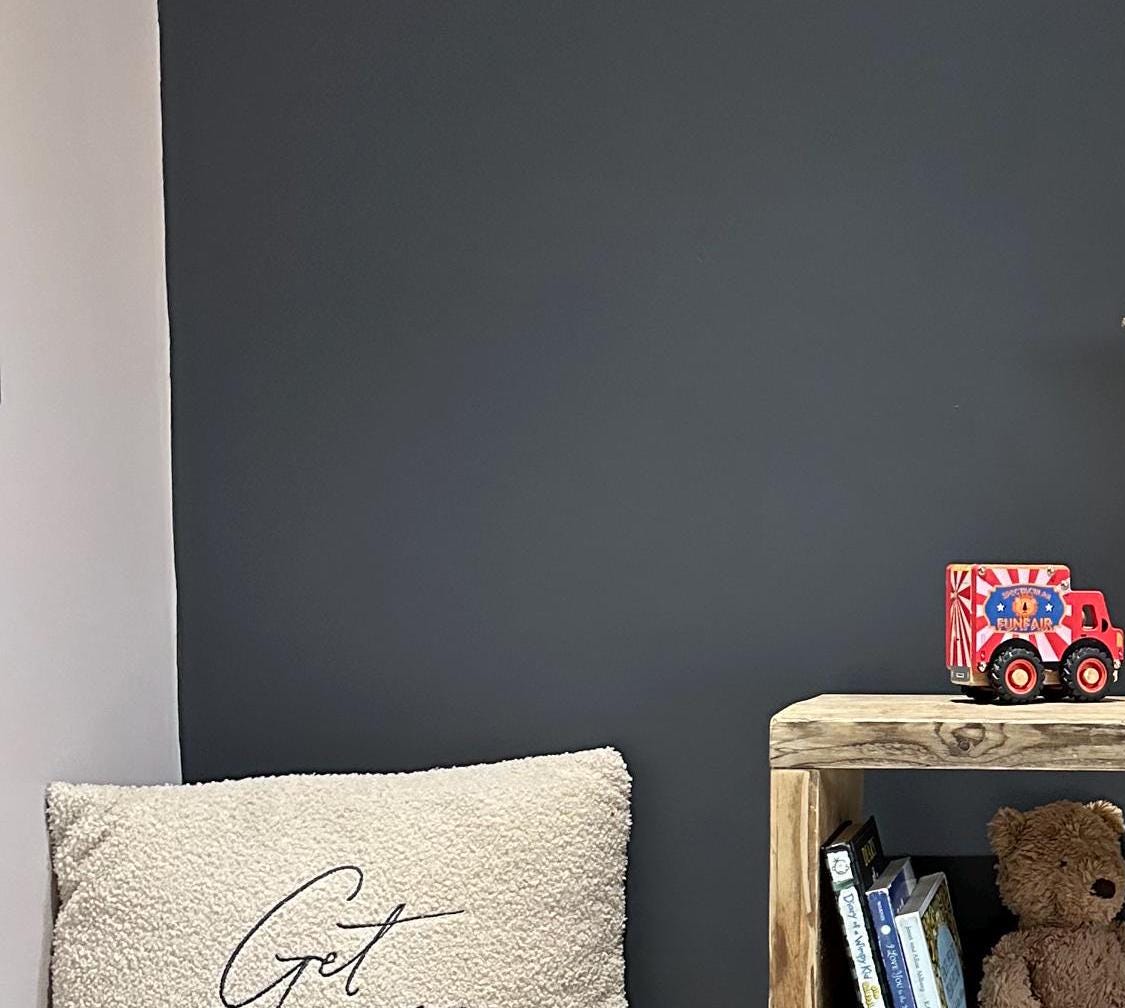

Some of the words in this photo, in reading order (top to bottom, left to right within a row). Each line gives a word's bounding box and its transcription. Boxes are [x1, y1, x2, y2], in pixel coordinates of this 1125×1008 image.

[996, 617, 1054, 632] FUNFAIR
[843, 894, 857, 920] Diary
[852, 936, 868, 965] Wimpy
[862, 965, 872, 979] Kid
